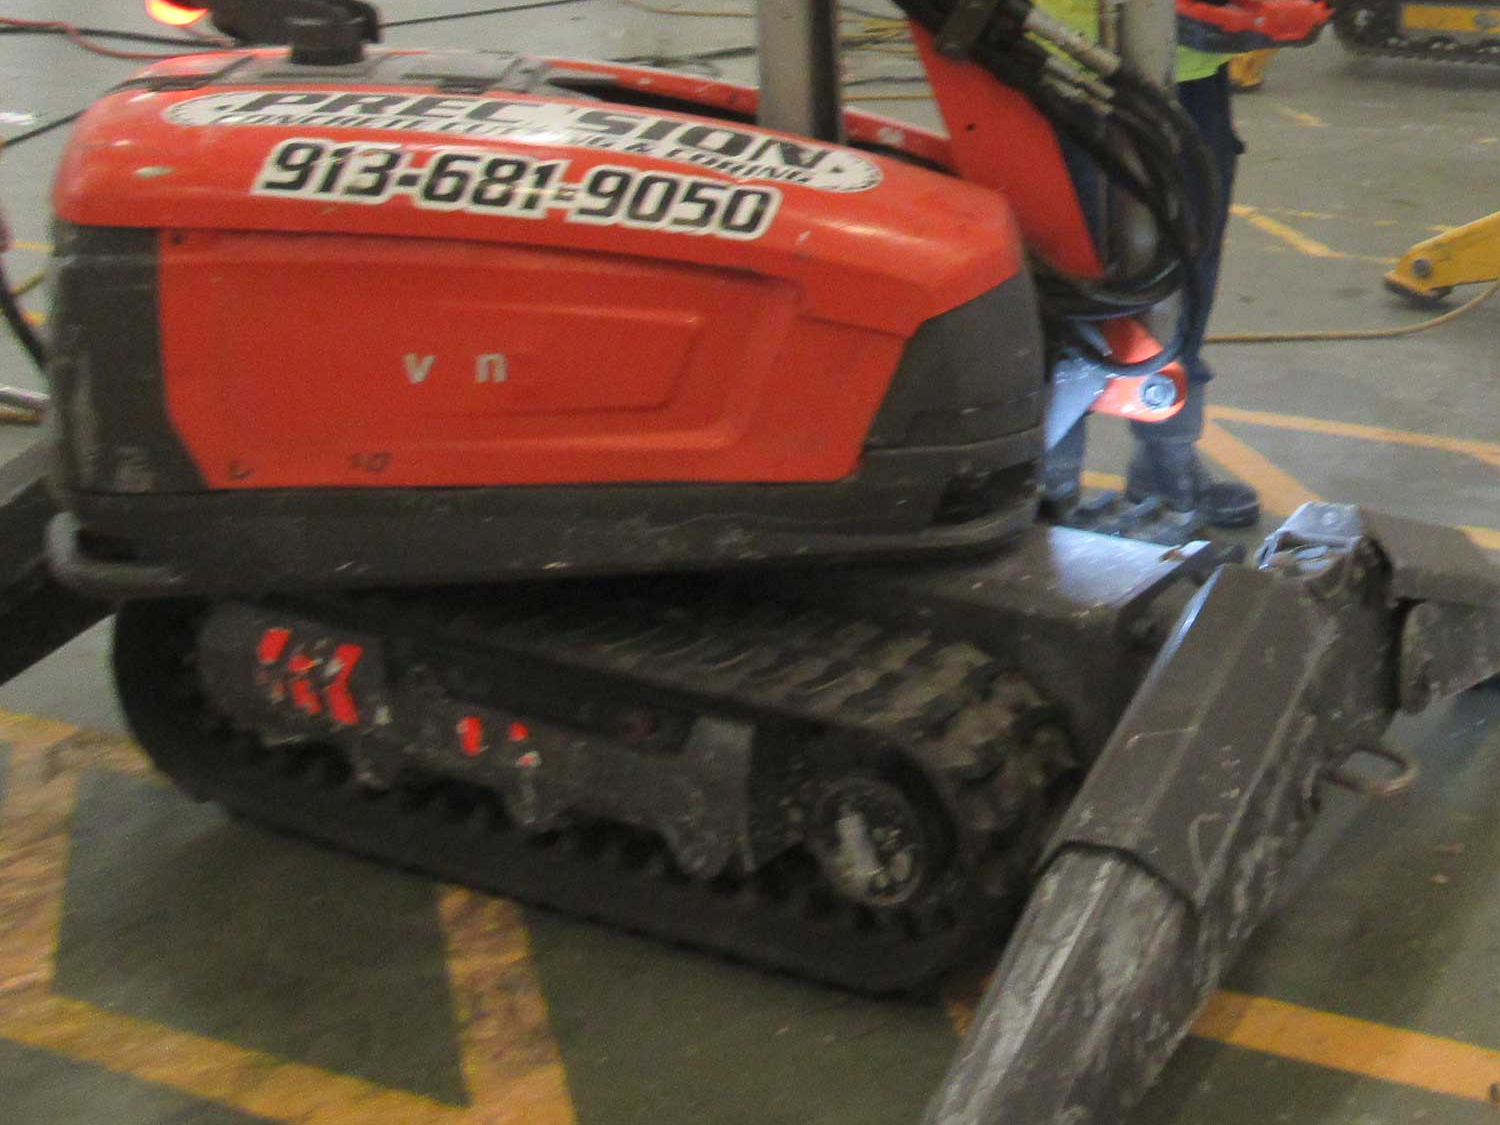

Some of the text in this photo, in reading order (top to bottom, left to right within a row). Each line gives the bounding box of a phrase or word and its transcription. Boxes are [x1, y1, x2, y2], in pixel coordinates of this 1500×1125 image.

[234, 92, 831, 171] PRECSION
[664, 148, 812, 182] CORING
[262, 141, 772, 234] 913-681-9050
